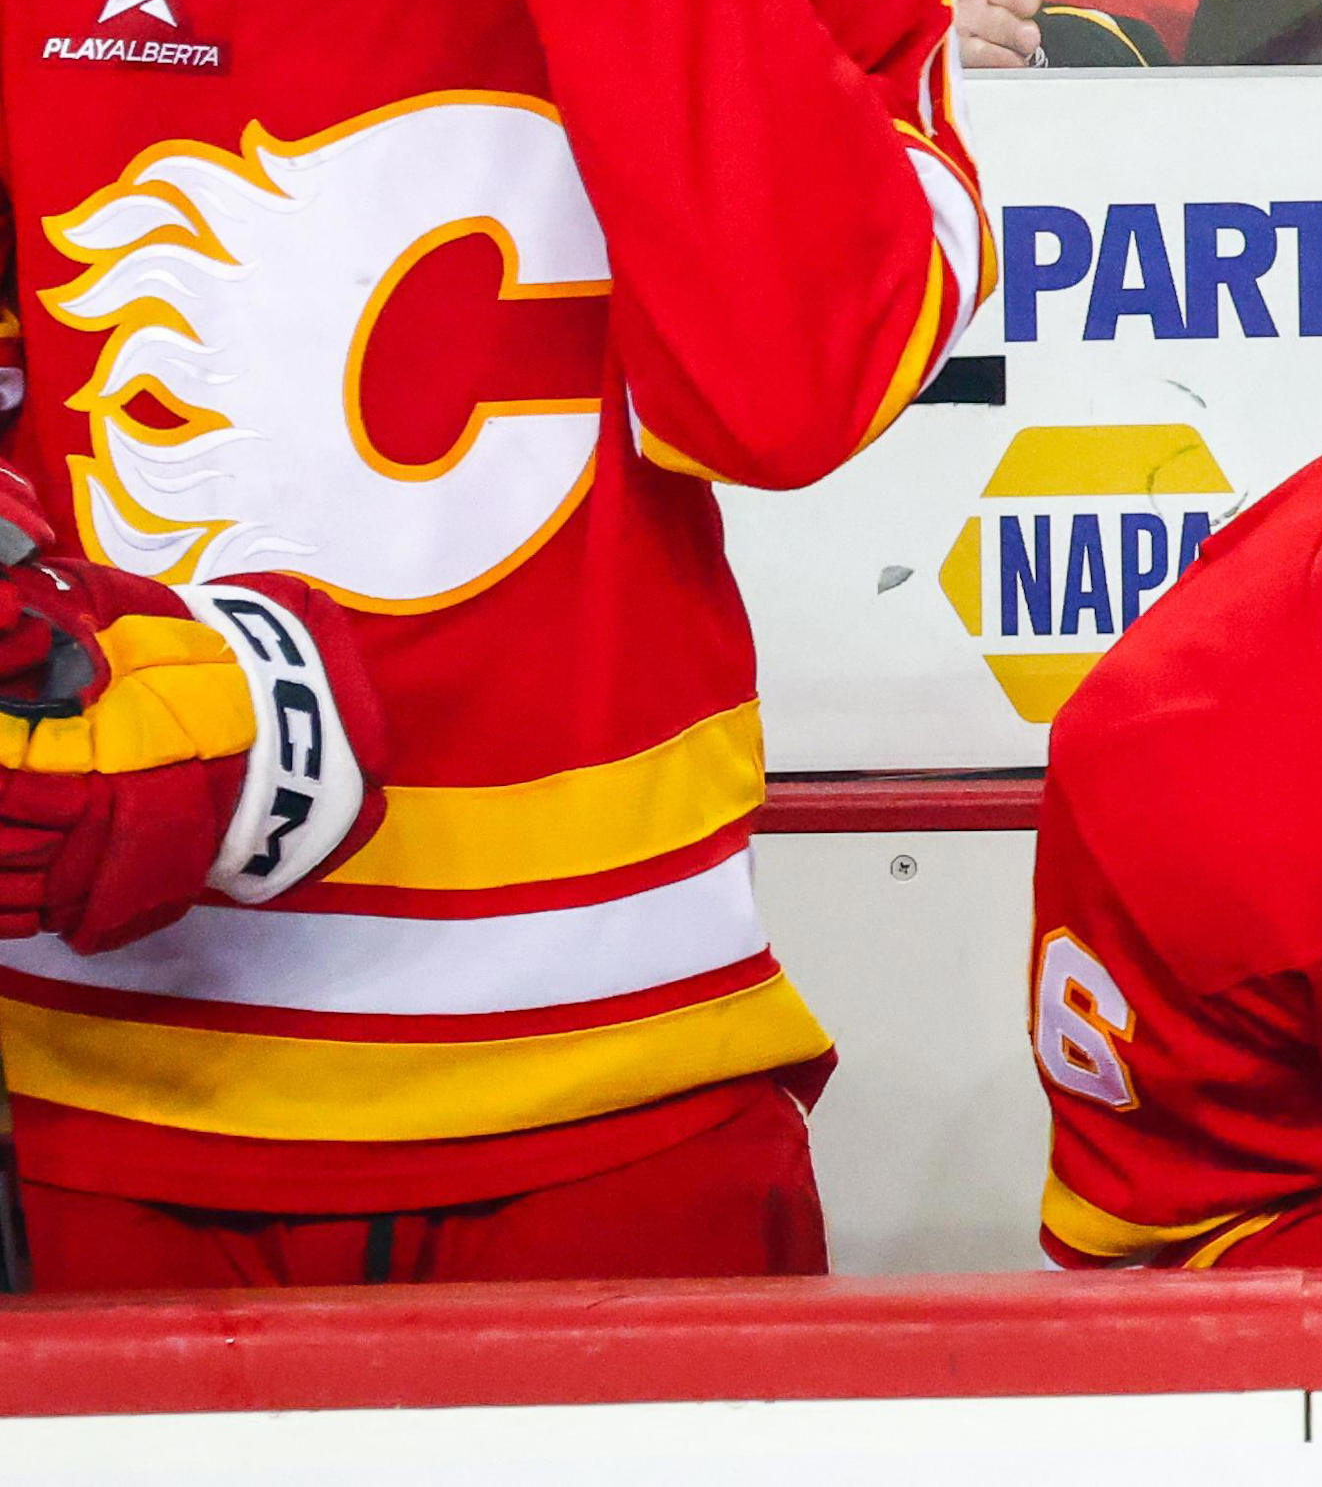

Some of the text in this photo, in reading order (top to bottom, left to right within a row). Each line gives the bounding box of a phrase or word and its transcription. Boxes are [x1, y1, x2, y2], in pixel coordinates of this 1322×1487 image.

[43, 37, 219, 66] PLAYALBERTA
[1000, 512, 1211, 636] NAP
[213, 598, 322, 877] CCM
[1031, 925, 1141, 1112] 6
